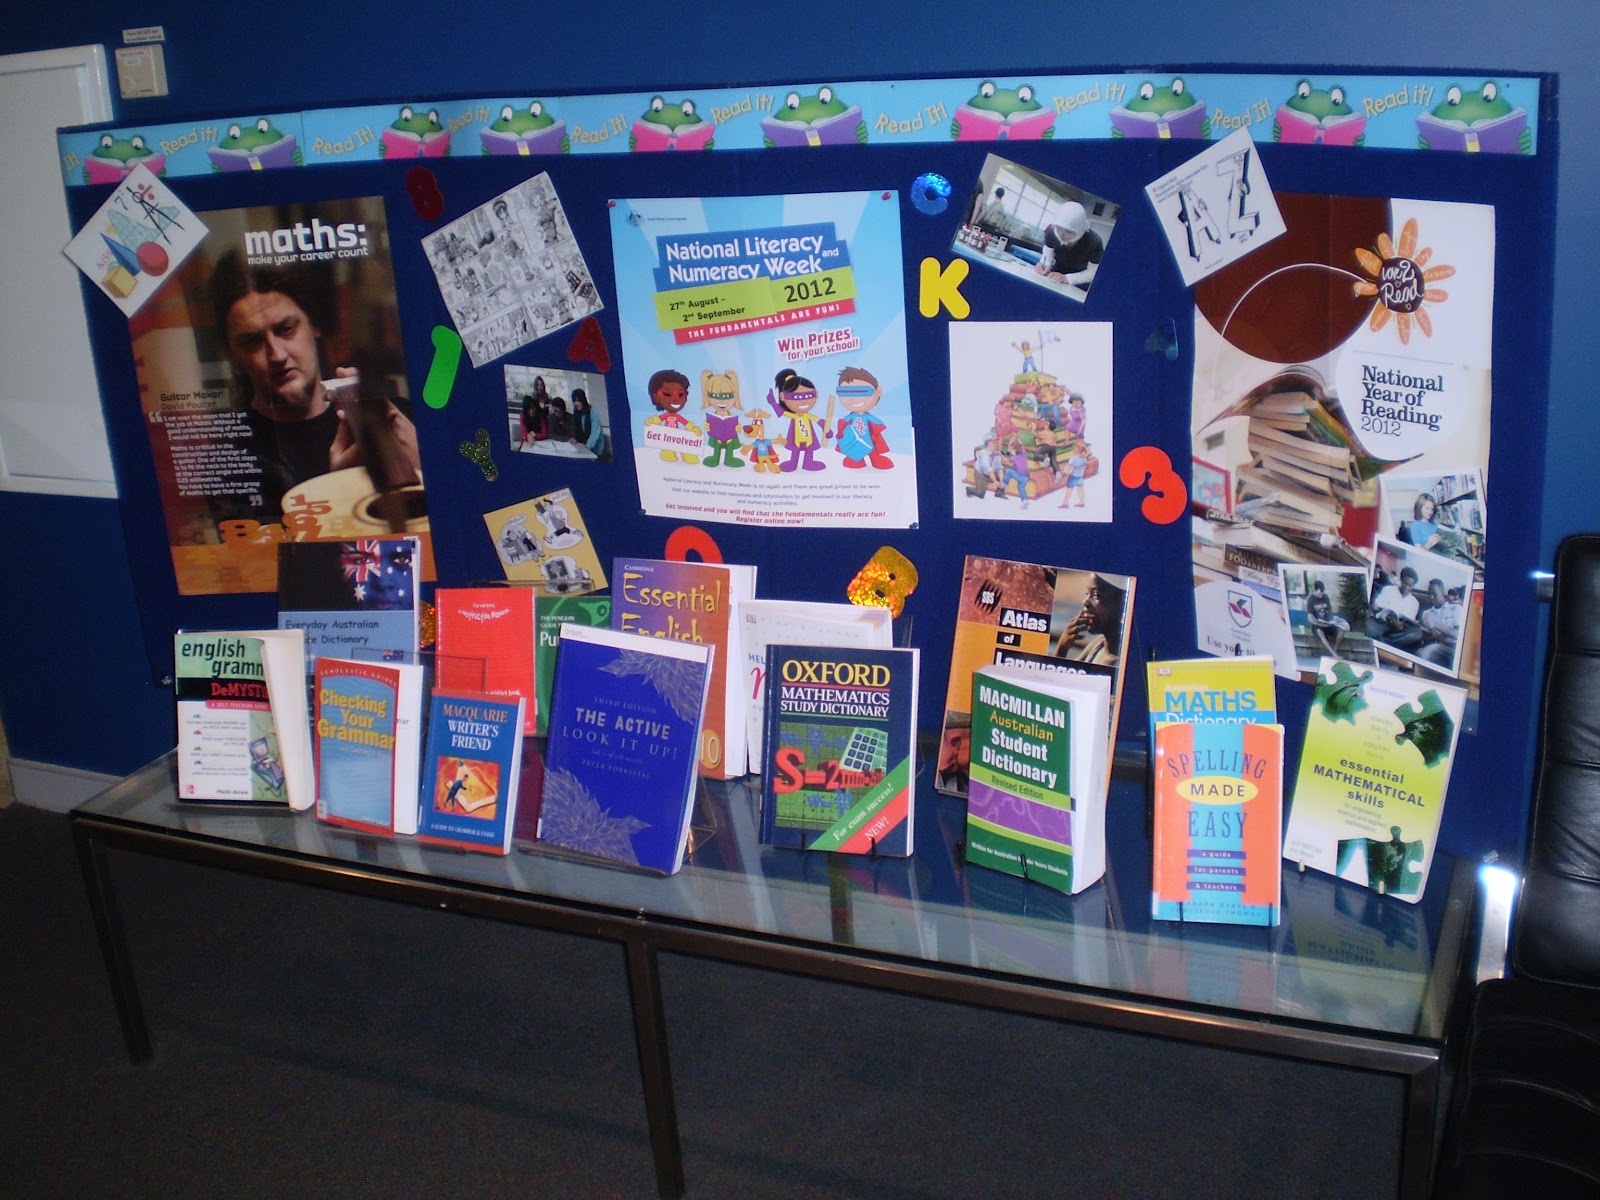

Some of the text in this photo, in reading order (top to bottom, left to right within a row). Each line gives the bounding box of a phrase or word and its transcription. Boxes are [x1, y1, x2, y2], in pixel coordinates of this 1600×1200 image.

[711, 93, 775, 125] Read it!
[1053, 83, 1127, 113] Read it!
[1363, 84, 1435, 118] Read it!
[875, 100, 949, 134] Read It!
[1212, 98, 1273, 129] Read It!
[160, 127, 218, 155] Read it!
[312, 126, 376, 156] Read It!
[571, 114, 628, 144] Read It!
[245, 218, 367, 254] maths:
[666, 235, 839, 262] National Literacy and
[248, 247, 368, 265] make your career count
[668, 256, 822, 284] Numeracy Week
[784, 277, 836, 303] 2012
[919, 256, 971, 320] K
[1381, 278, 1426, 307] Read
[688, 297, 719, 309] August
[696, 307, 745, 321] September
[688, 303, 840, 339] THE FUNDAMENTALS ARE FUN!
[777, 329, 851, 353] Win Prizes
[787, 339, 859, 360] for your school!
[1362, 365, 1444, 392] National
[160, 391, 223, 401] Guitar Maker
[1362, 382, 1425, 407] Year of
[1361, 399, 1442, 431] Reading
[1361, 416, 1401, 437] 2012
[647, 431, 702, 447] Get Involved!
[1119, 445, 1187, 525] 3
[623, 573, 720, 614] Essential
[982, 591, 995, 604] SBS
[286, 620, 379, 631] Everyday Australian
[1002, 610, 1047, 632] Atlas
[181, 639, 245, 660] english
[322, 635, 368, 645] Dictionary
[1004, 635, 1014, 644] of
[1207, 635, 1222, 648] Use
[211, 659, 264, 677] gramm
[749, 654, 766, 664] HEL
[782, 660, 891, 687] OXFORD
[320, 689, 387, 717] Checking
[781, 687, 890, 706] MATHEMATICS
[781, 701, 889, 717] STUDY DICTIONARY
[979, 686, 1066, 729] MACMILLAN
[1165, 690, 1257, 712] MATHS
[341, 708, 374, 728] Your
[443, 704, 508, 723] MACQUARIE
[576, 707, 670, 740] THE ACTIVE
[989, 710, 1054, 742] Australian
[317, 718, 395, 750] Grammar
[448, 720, 499, 737] WRITER'S
[451, 735, 491, 751] FRIEND
[563, 726, 609, 745] LOOK
[622, 738, 638, 750] IT
[650, 744, 677, 759] UP!
[991, 728, 1048, 761] Student
[982, 746, 1057, 789] Dictionary
[1168, 749, 1267, 779] SPELLING
[1340, 759, 1405, 784] essential
[991, 775, 1044, 800] Revised Edition
[1191, 783, 1245, 797] MADE
[1314, 764, 1425, 807] MATHEMATICAL
[833, 783, 894, 841] For exam success!
[1347, 790, 1385, 809] skills
[865, 817, 890, 841] NEW!
[1188, 811, 1248, 839] EASY
